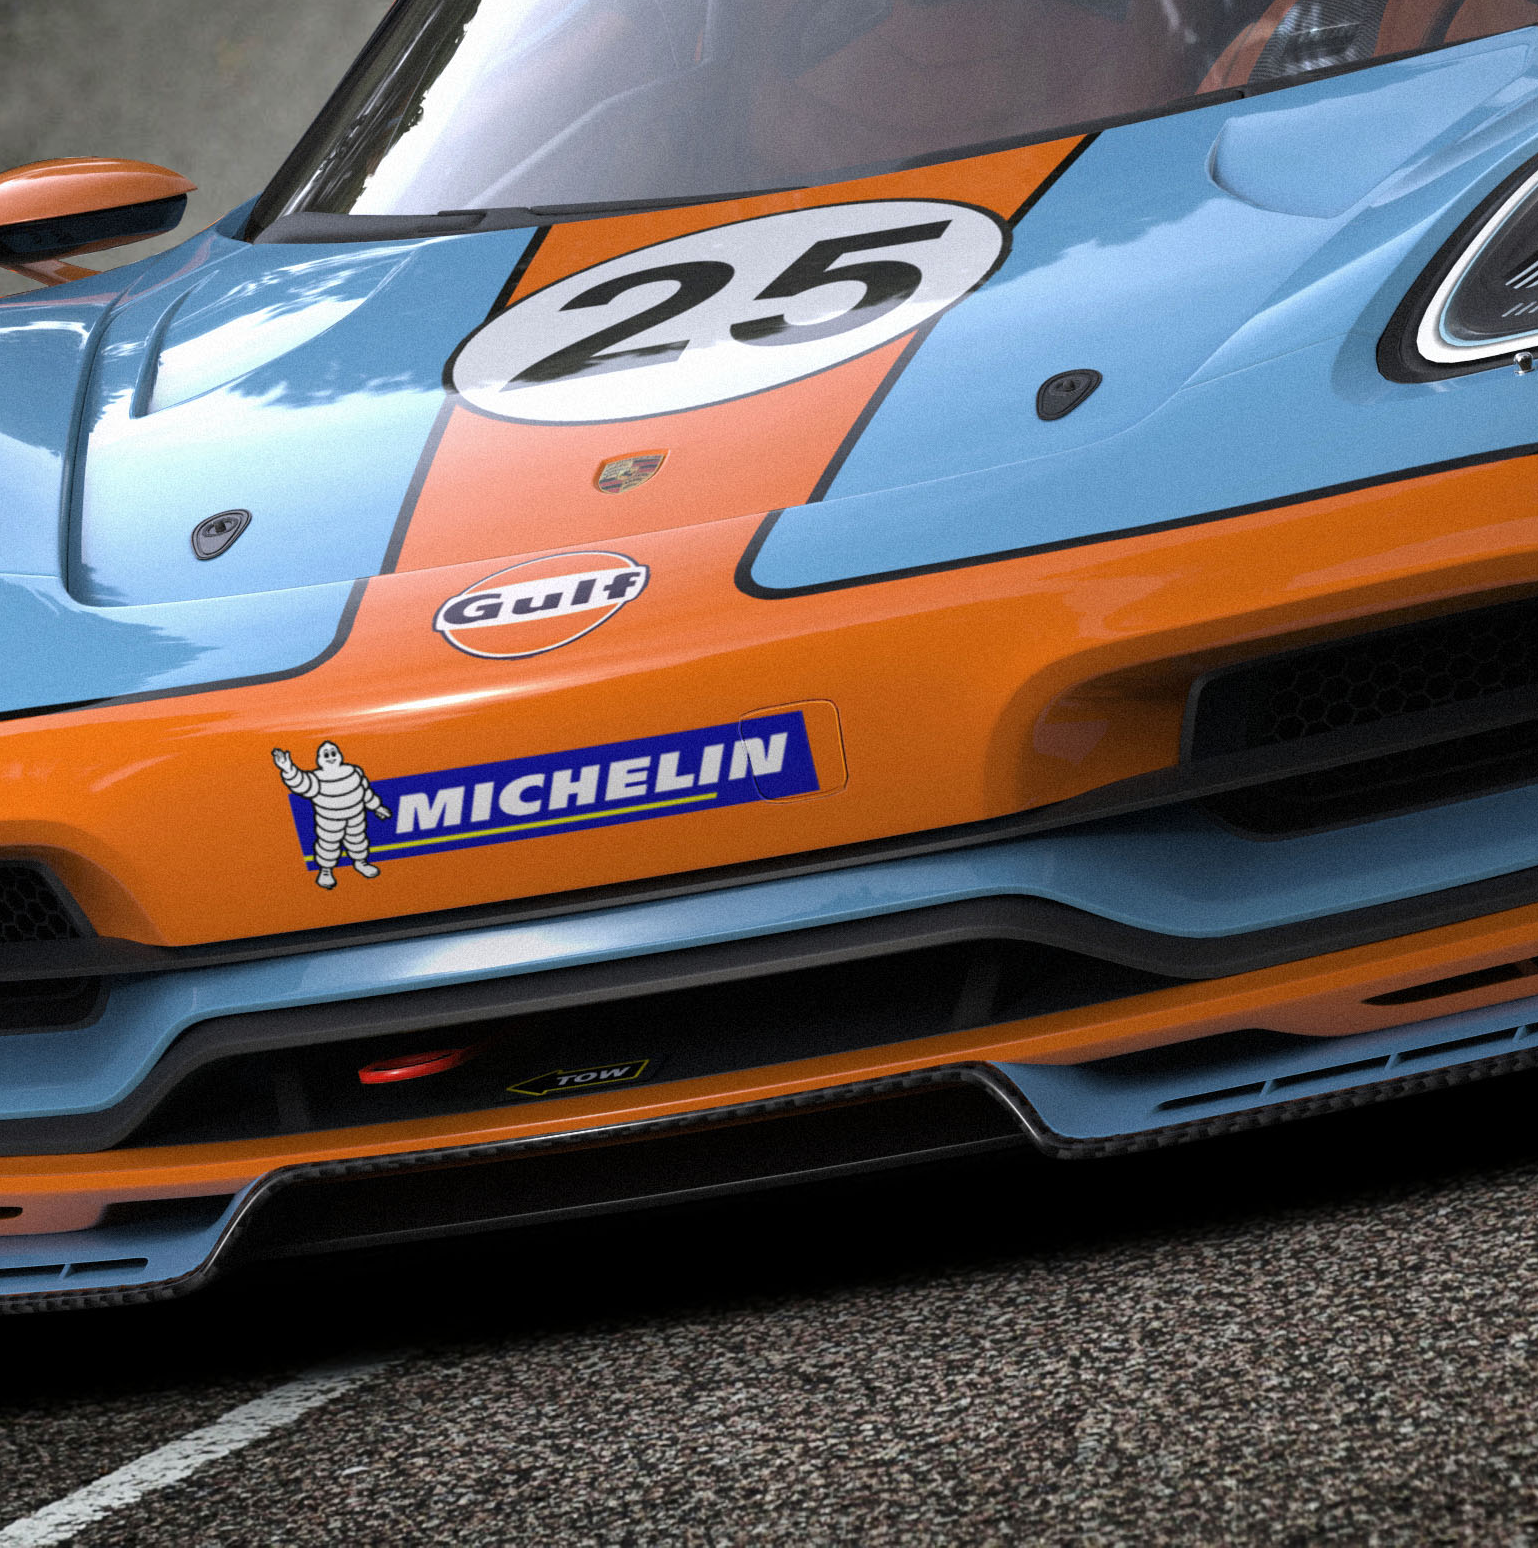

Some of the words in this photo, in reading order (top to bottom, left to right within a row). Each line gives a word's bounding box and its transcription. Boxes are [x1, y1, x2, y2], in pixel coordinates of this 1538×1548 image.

[499, 219, 953, 393] 25
[443, 571, 641, 625] Gulf
[395, 732, 788, 834] MICHELIN
[556, 1065, 632, 1086] TOW
